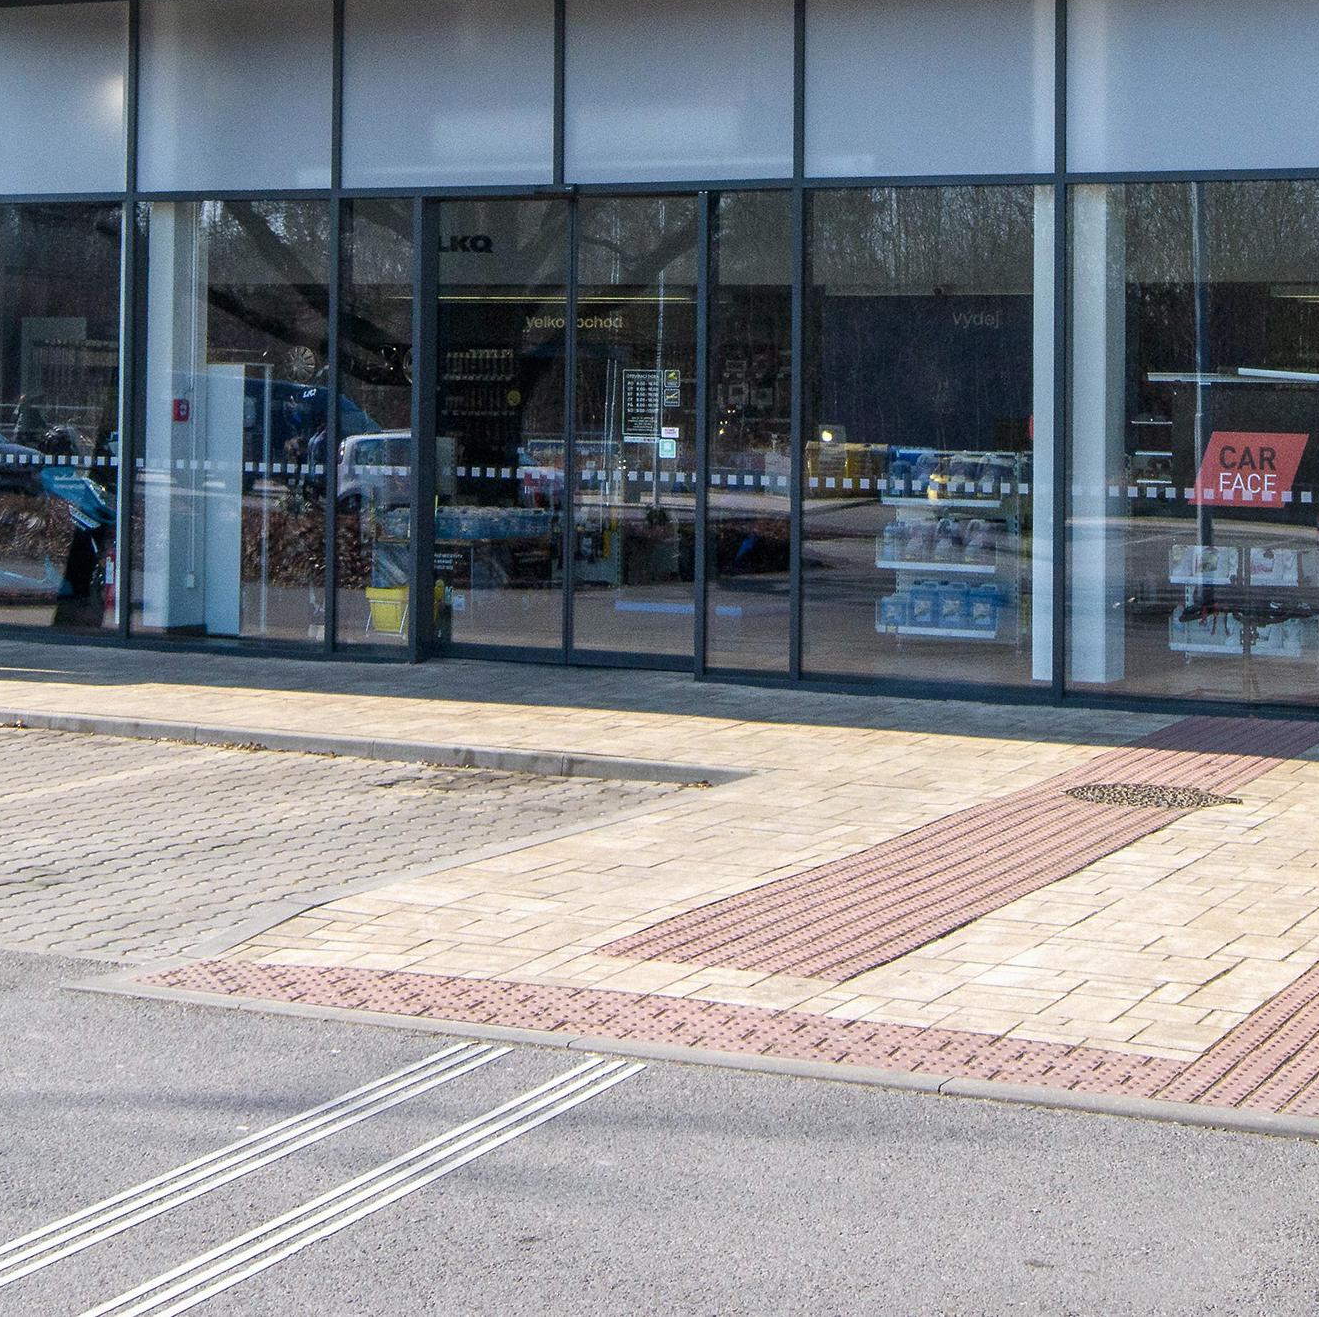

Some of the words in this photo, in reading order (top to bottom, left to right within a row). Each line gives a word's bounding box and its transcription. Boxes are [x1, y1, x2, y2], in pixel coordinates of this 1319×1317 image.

[438, 235, 494, 253] LKQ
[525, 315, 624, 329] Velkochod
[1219, 445, 1277, 471] CAR
[1219, 472, 1277, 494] FACE
